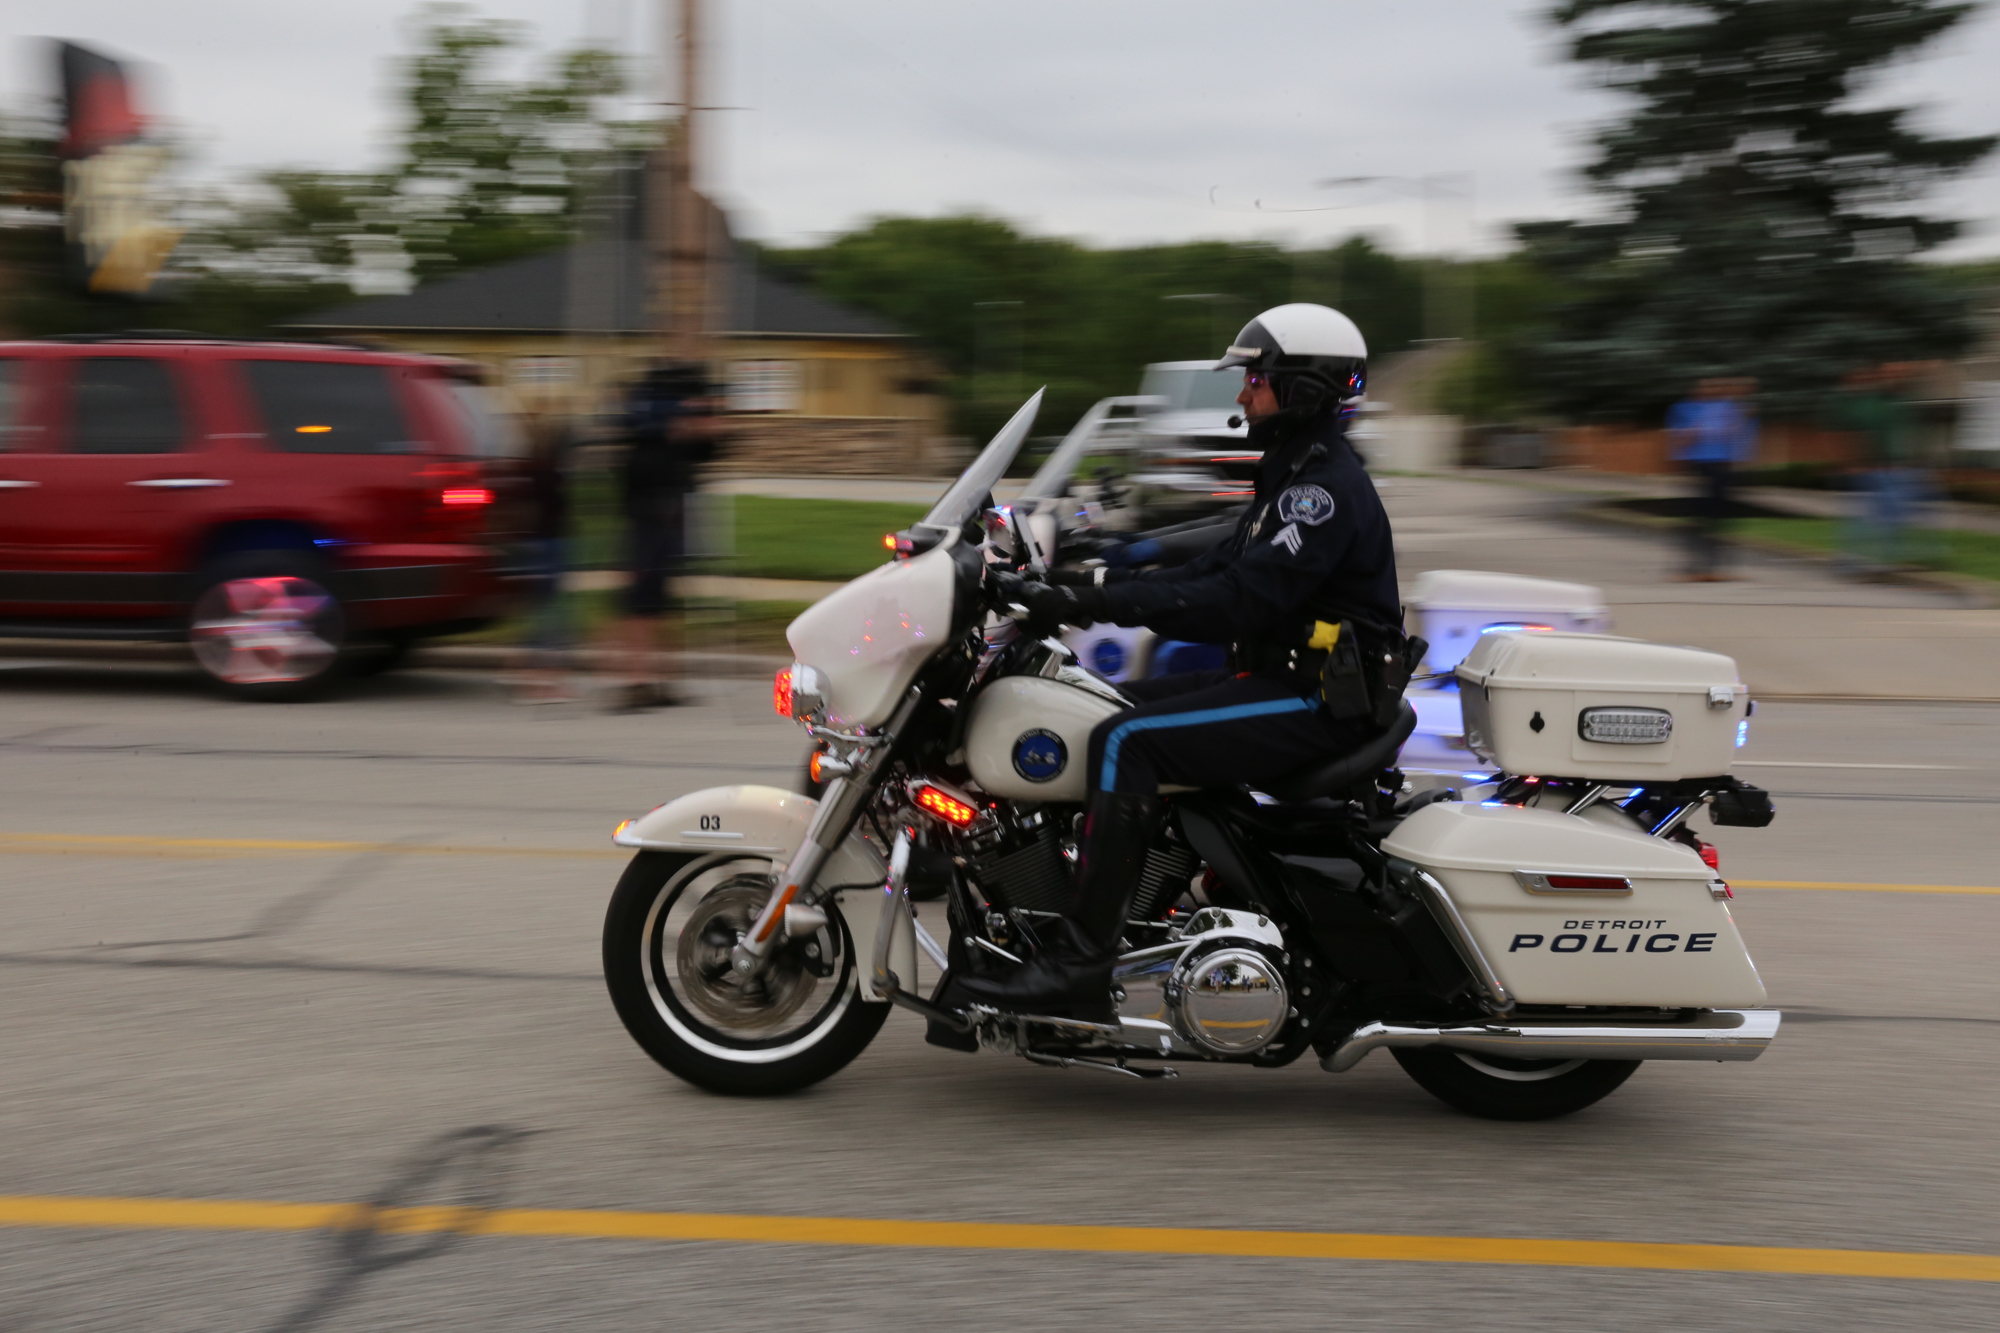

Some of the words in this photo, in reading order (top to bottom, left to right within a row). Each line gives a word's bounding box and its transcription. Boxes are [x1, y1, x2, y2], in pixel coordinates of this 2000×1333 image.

[700, 815, 721, 830] 03
[1563, 920, 1667, 930] DETROIT
[1508, 932, 1718, 953] POLICE
